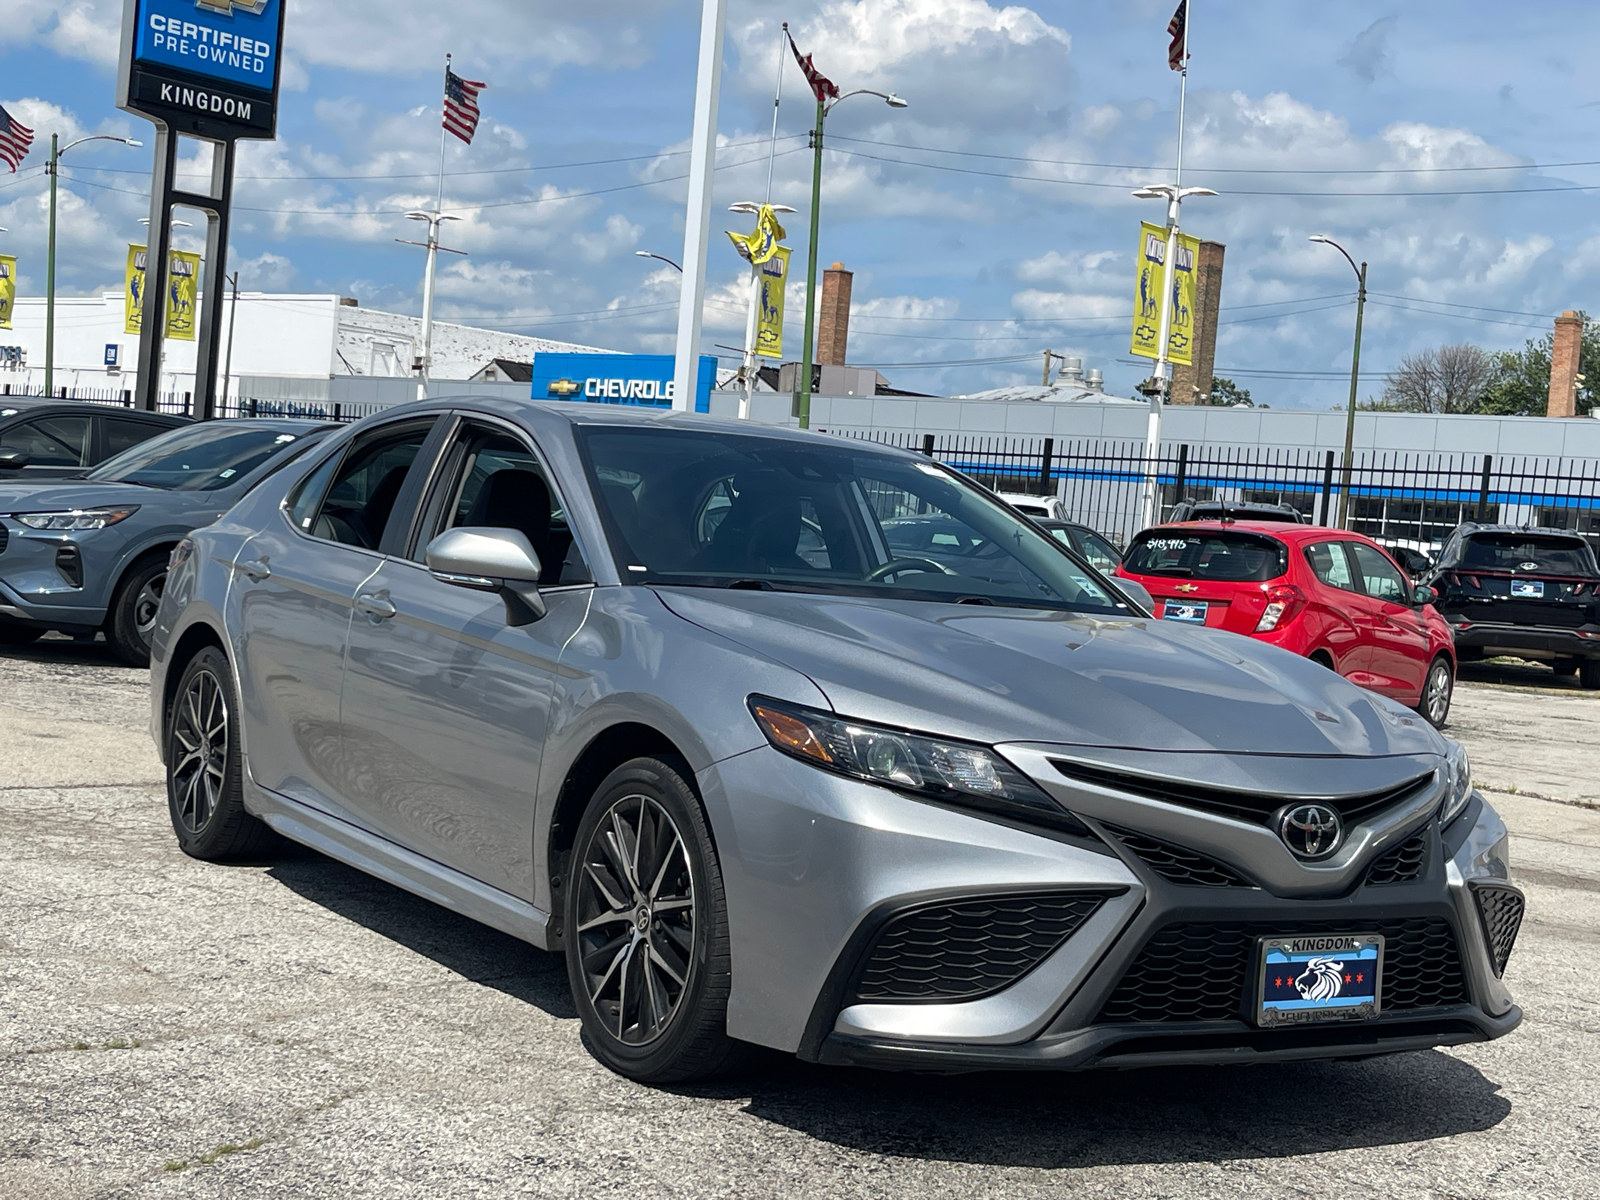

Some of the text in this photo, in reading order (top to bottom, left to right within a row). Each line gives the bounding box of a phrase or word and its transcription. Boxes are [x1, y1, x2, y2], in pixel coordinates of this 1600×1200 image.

[150, 13, 270, 58] CERTIFIED
[153, 32, 265, 74] PRE-OWNED
[160, 83, 251, 121] KINGDOM
[1145, 232, 1166, 264] King
[584, 378, 674, 400] CHEVROLE
[1291, 937, 1355, 952] KINGDOM
